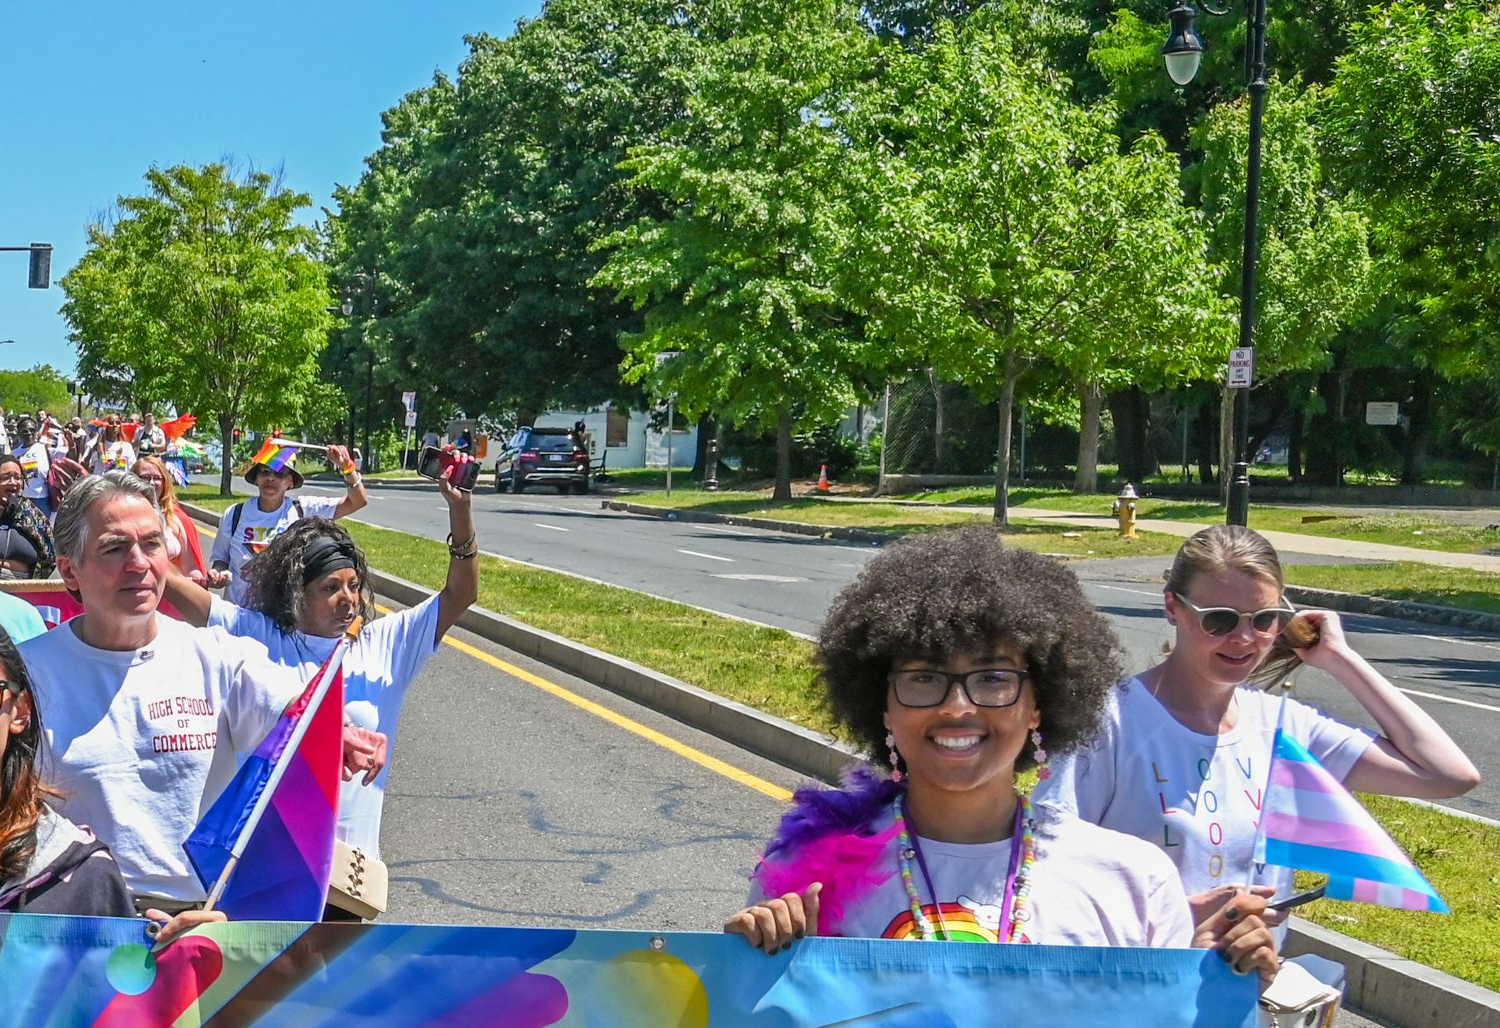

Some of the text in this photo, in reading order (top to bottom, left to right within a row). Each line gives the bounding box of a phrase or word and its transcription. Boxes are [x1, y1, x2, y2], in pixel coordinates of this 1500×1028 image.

[1235, 351, 1245, 360] NO
[148, 696, 214, 720] HIGH SCHOOL
[177, 719, 190, 728] OF
[153, 732, 217, 754] COMMERCE
